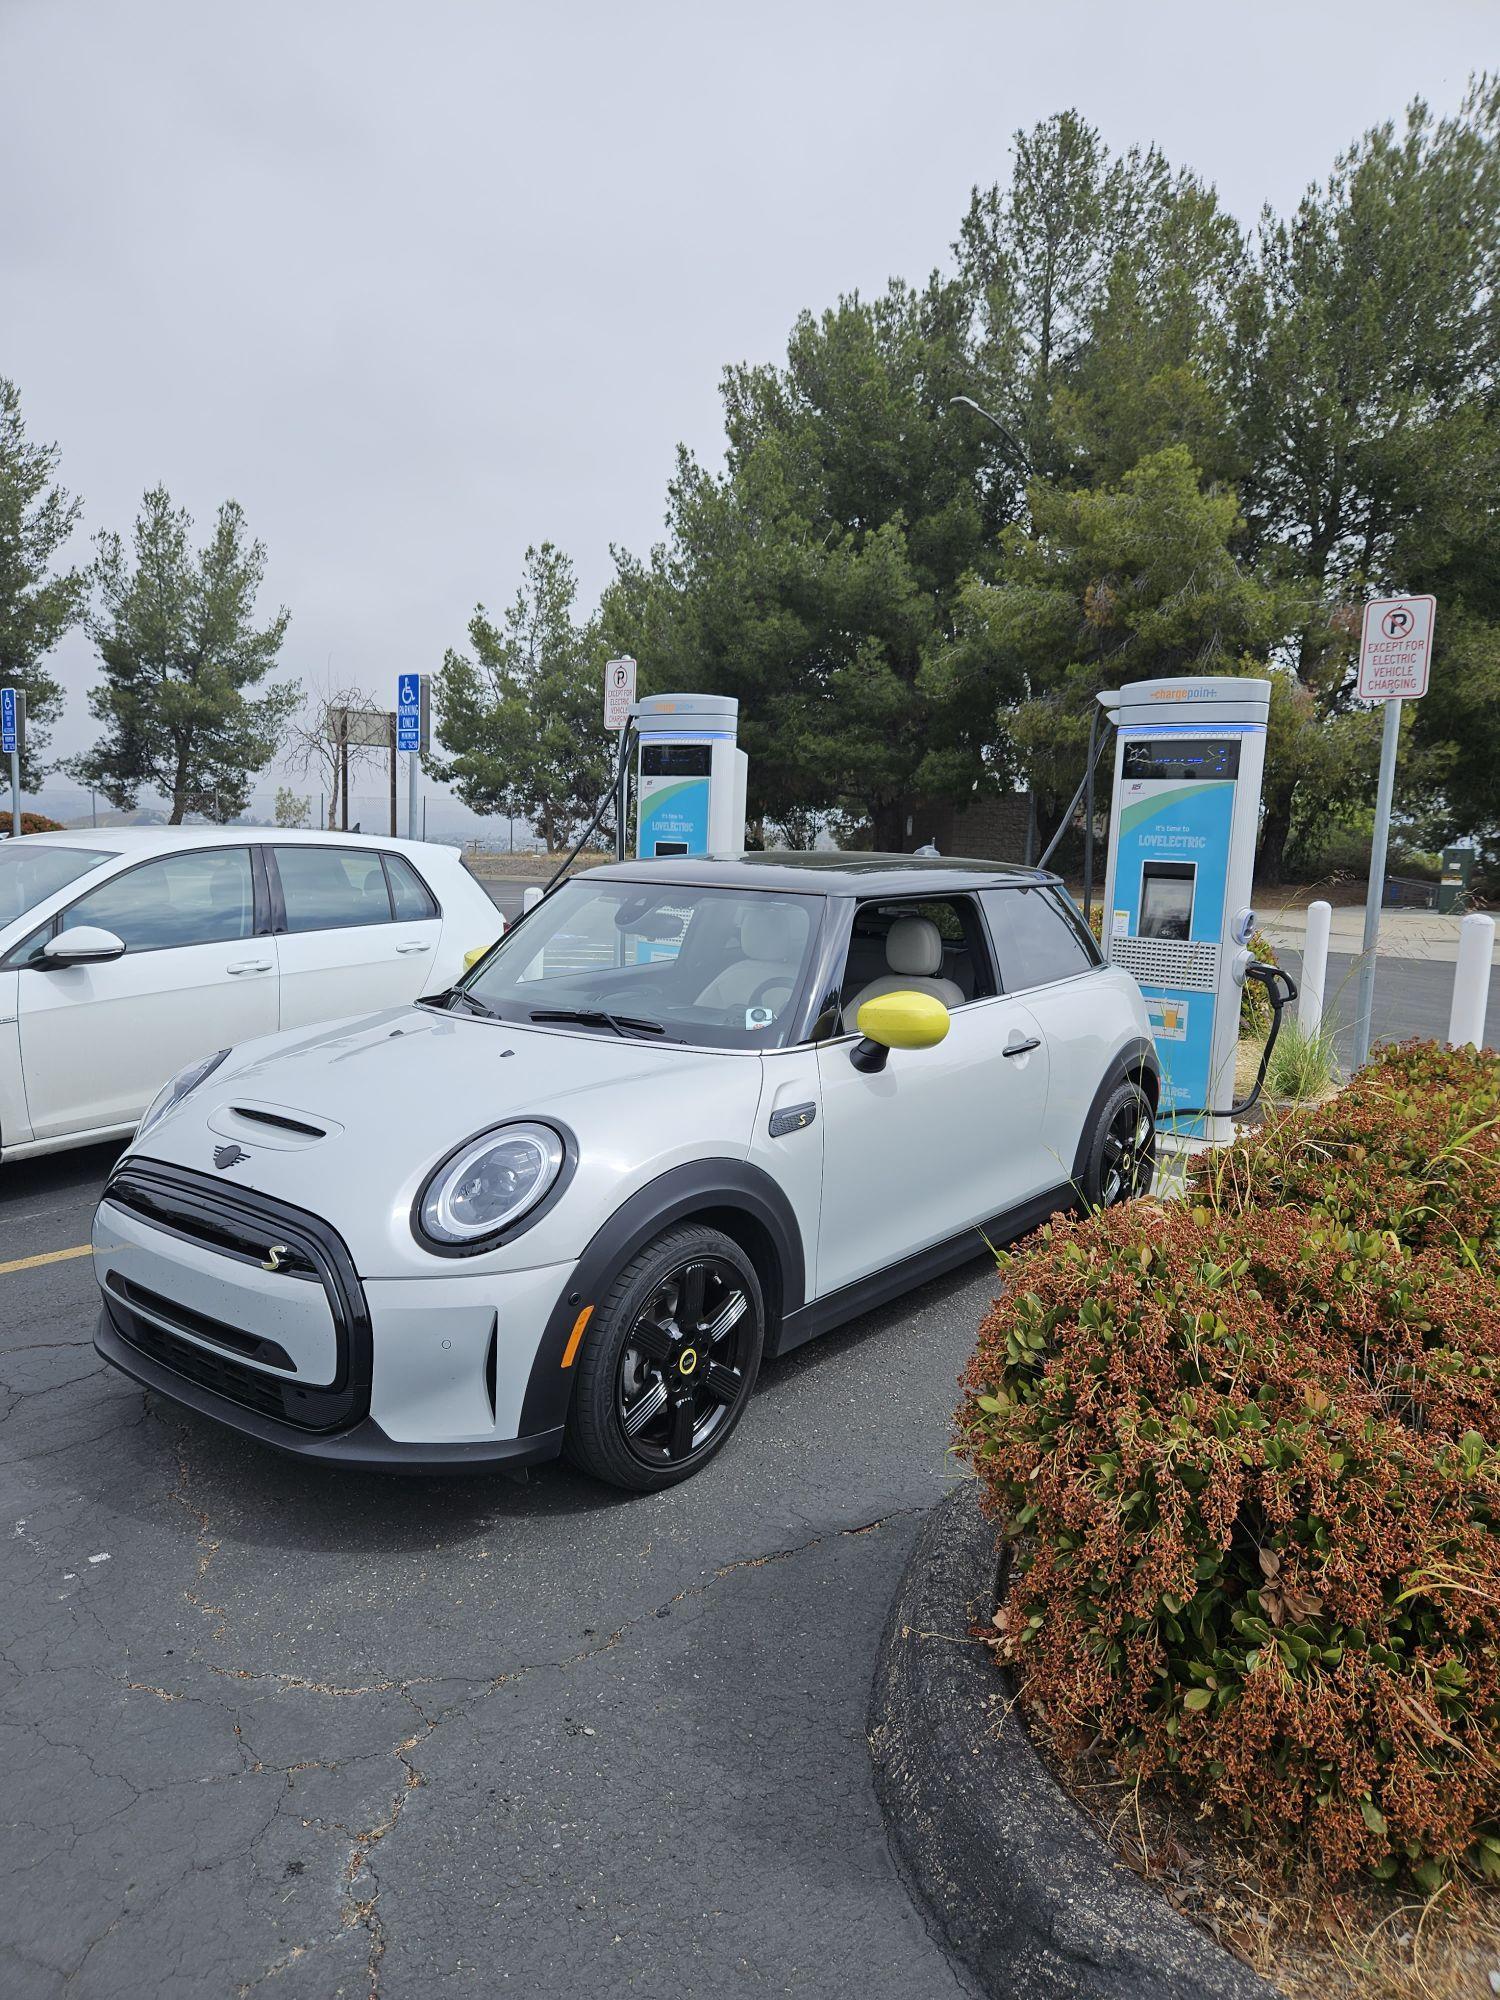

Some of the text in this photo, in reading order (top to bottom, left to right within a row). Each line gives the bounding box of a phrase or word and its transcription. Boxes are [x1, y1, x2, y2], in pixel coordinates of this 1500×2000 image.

[1368, 640, 1425, 653] EXCEPT FOR
[1372, 653, 1417, 665] ELECTRIC
[1373, 665, 1414, 677] VEHICLE
[1368, 678, 1417, 690] CHARGING
[610, 698, 629, 706] ELECTRIC
[399, 705, 419, 716] PARKING
[402, 717, 415, 728] ONLY
[608, 715, 628, 723] CHARGIN
[1138, 834, 1207, 848] LOVELECTRIC
[798, 1114, 806, 1125] S
[261, 1245, 287, 1270] S
